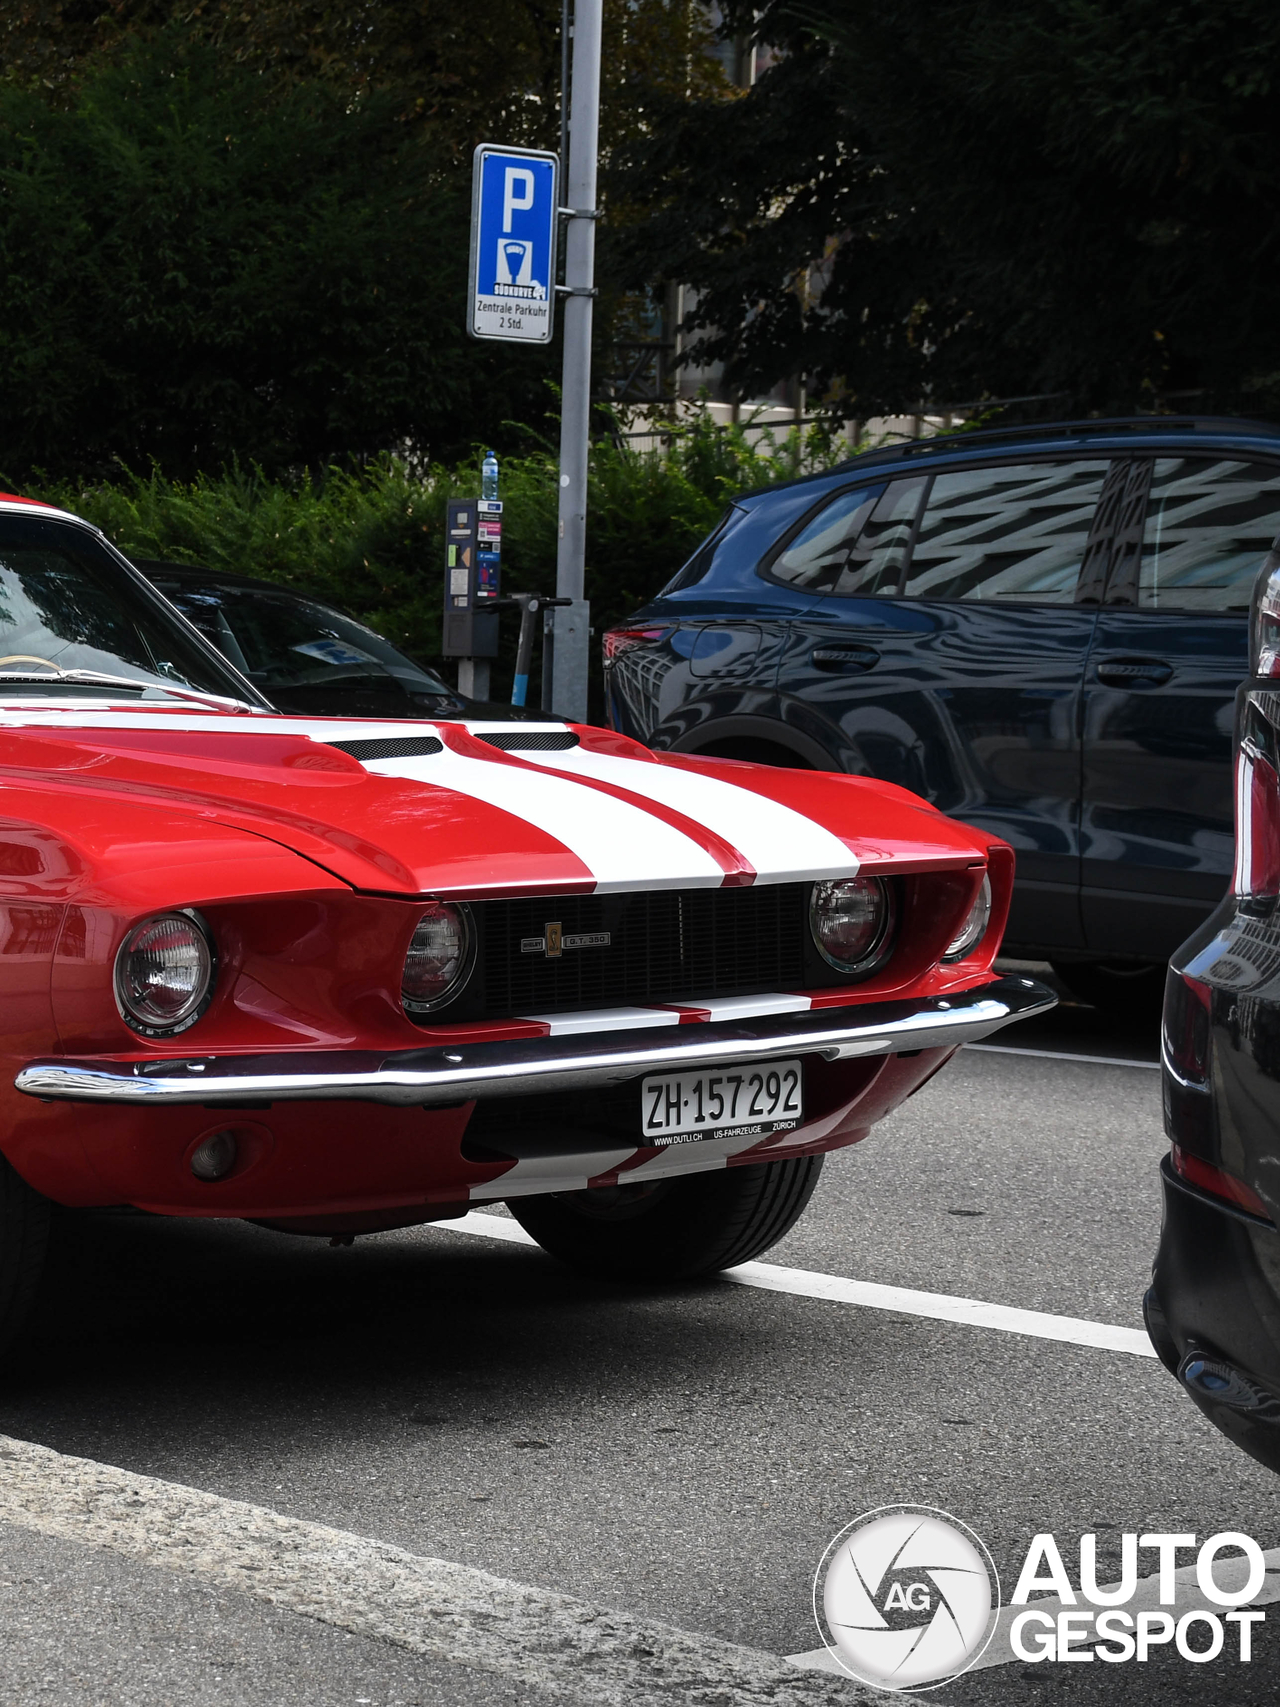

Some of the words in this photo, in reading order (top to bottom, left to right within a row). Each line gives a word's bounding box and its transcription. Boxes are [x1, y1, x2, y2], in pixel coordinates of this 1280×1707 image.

[503, 167, 534, 233] P
[494, 283, 533, 298] SÜDKURVE
[477, 300, 513, 315] Zentrale
[515, 304, 547, 317] Parkuhr
[499, 317, 505, 328] 2
[507, 317, 524, 330] Std.
[589, 936, 605, 944] 350
[654, 1132, 703, 1146] WWW.DUTLI.CH
[713, 1125, 762, 1139] US-FAHRZEUGE
[772, 1120, 796, 1131] ZÜRICH
